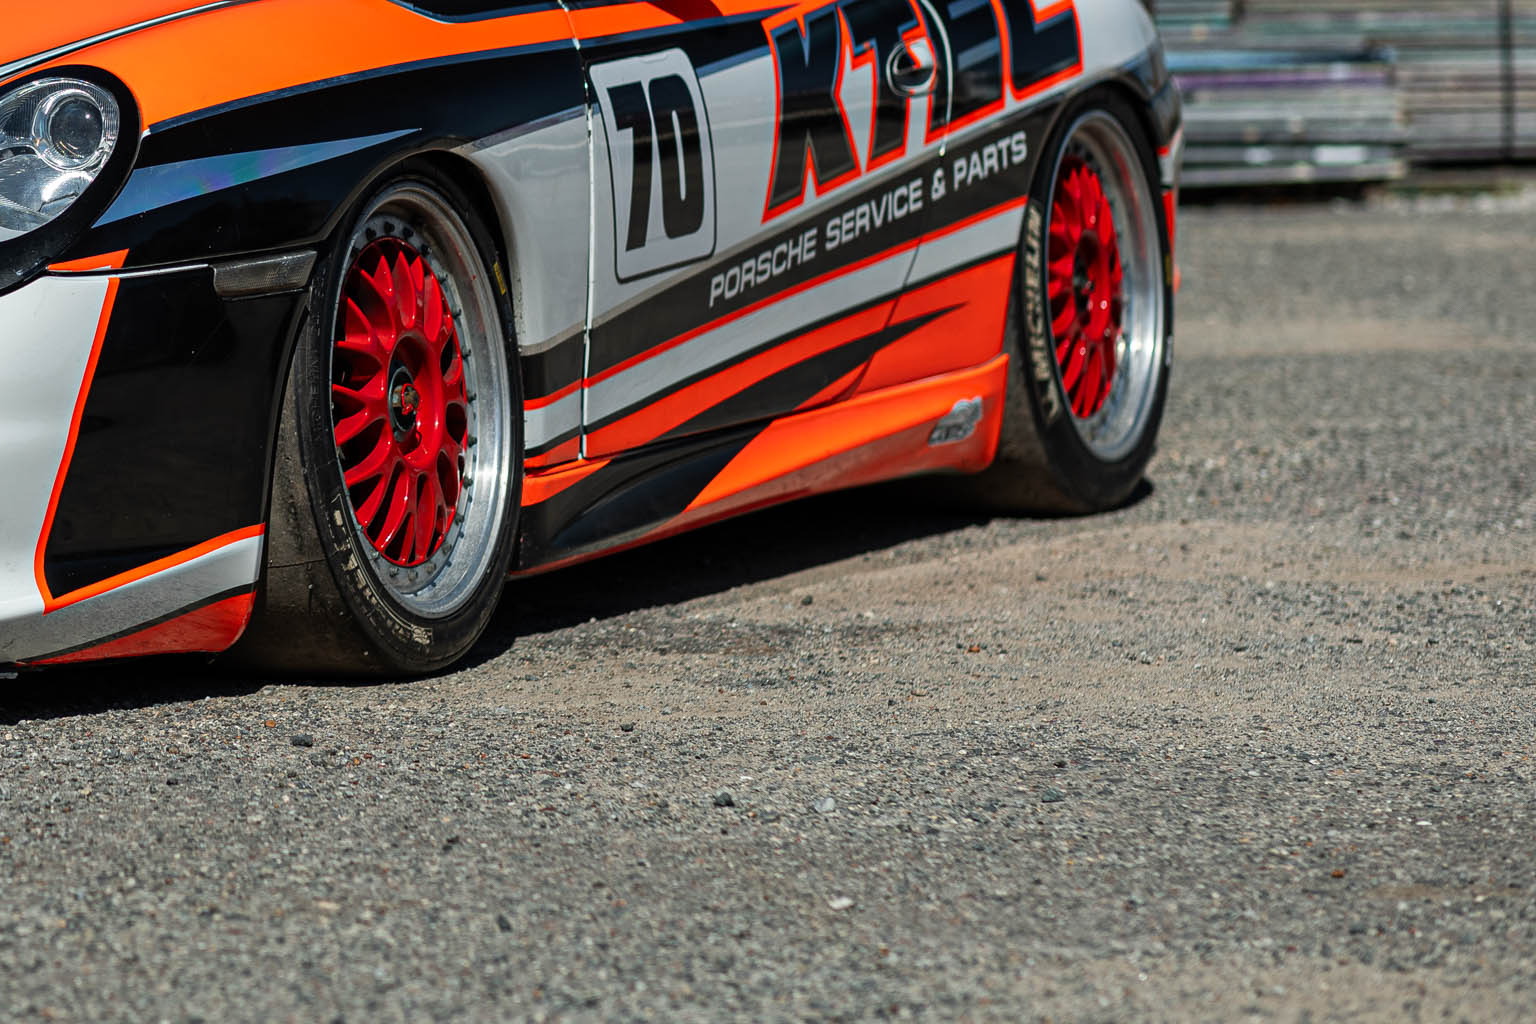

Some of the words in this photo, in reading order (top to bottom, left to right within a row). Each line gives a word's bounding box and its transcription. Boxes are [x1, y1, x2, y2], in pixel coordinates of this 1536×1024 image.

[608, 72, 706, 252] 70
[709, 227, 817, 308] PORSCHE
[825, 178, 923, 251] SERVICE
[931, 168, 946, 201] &
[953, 131, 1027, 191] PARTS
[1023, 204, 1051, 381] MICHELIN
